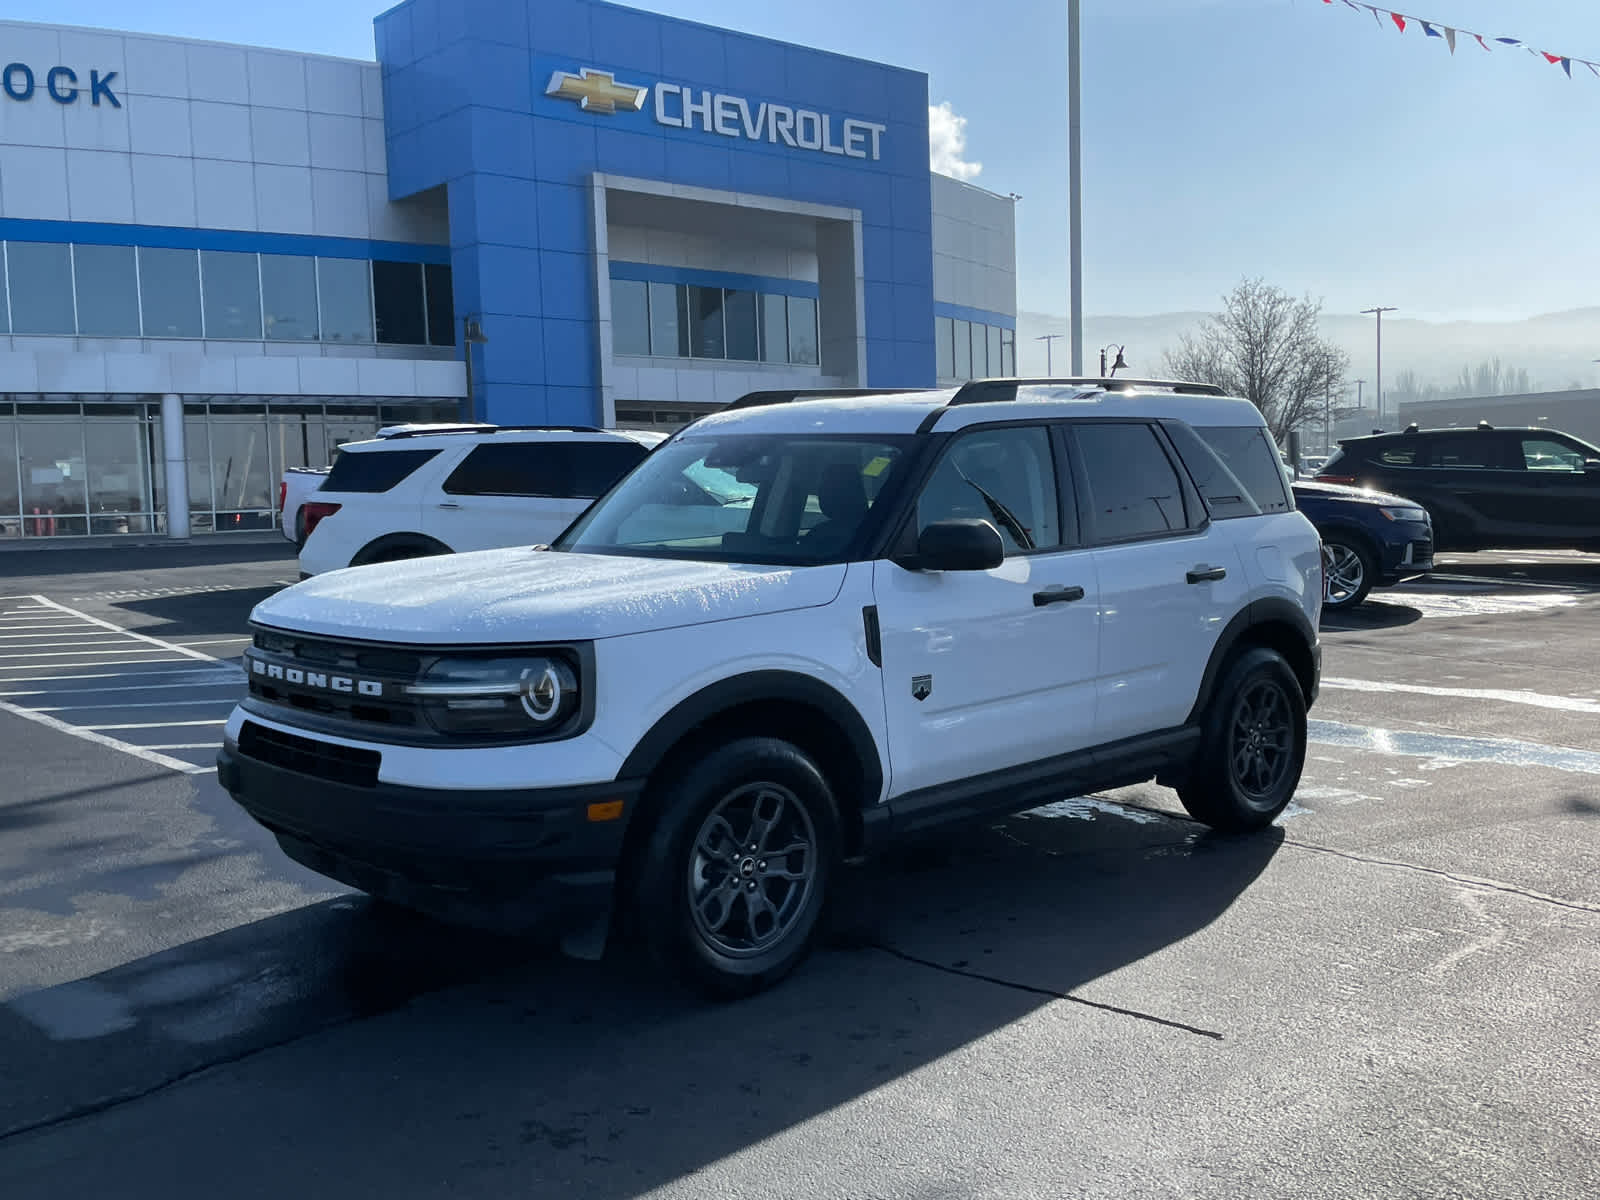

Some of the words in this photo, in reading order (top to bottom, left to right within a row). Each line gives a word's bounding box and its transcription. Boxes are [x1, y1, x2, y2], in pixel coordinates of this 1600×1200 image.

[3, 62, 121, 108] OCK
[655, 82, 886, 160] CHEVROLET
[252, 660, 382, 696] BRONCO
